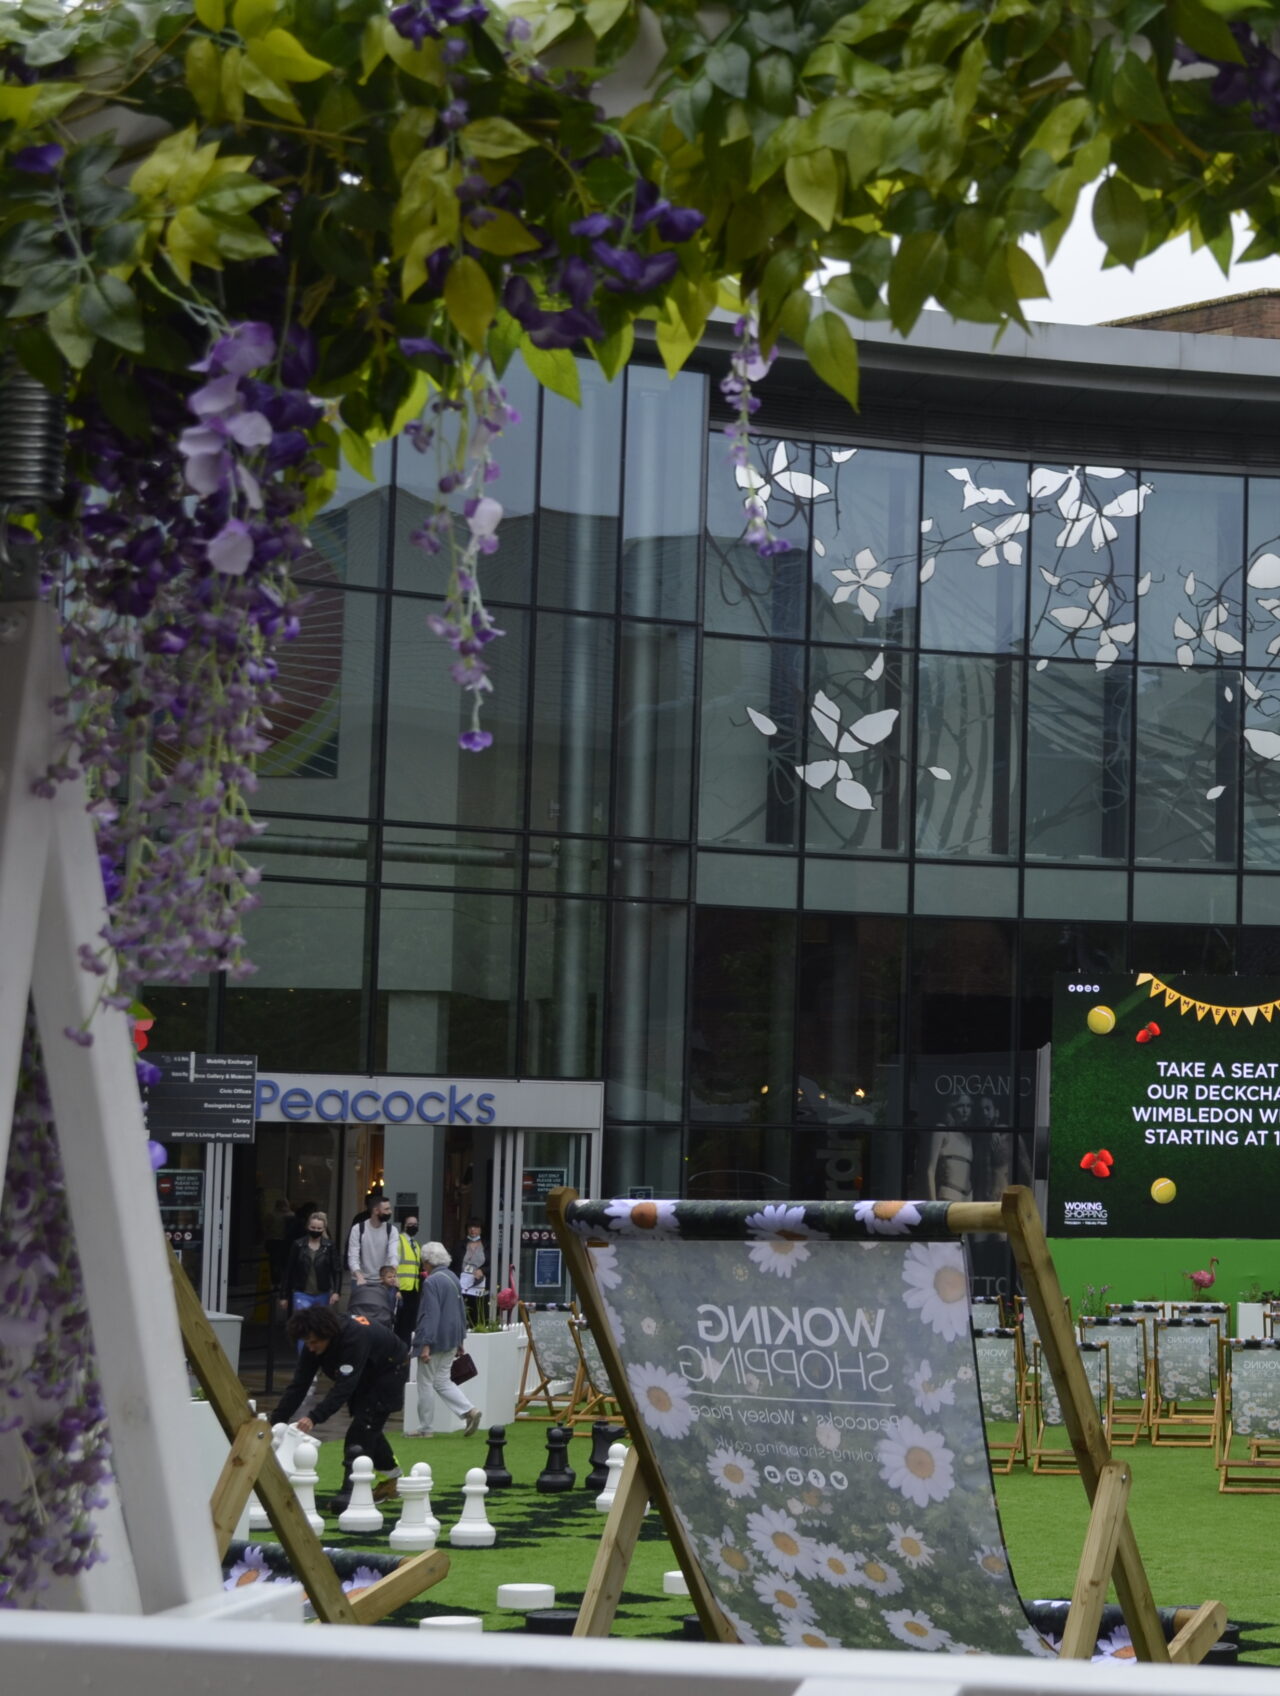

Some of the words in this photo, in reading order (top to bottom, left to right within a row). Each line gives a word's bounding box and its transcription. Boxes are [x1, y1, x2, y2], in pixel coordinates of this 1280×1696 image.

[1153, 983, 1238, 1018] SUMMER
[1157, 1061, 1206, 1078] TAKE
[1211, 1062, 1226, 1078] A
[1231, 1062, 1279, 1079] SEAT
[935, 1074, 1033, 1096] ORGANC
[1147, 1084, 1189, 1100] OUR
[255, 1079, 497, 1125] Peacocks
[1132, 1106, 1253, 1124] WIMBLEDON
[1144, 1129, 1240, 1146] STARTING
[1244, 1130, 1268, 1146] AT
[1064, 1201, 1103, 1210] WOKING
[1064, 1209, 1108, 1219] SHOPPING
